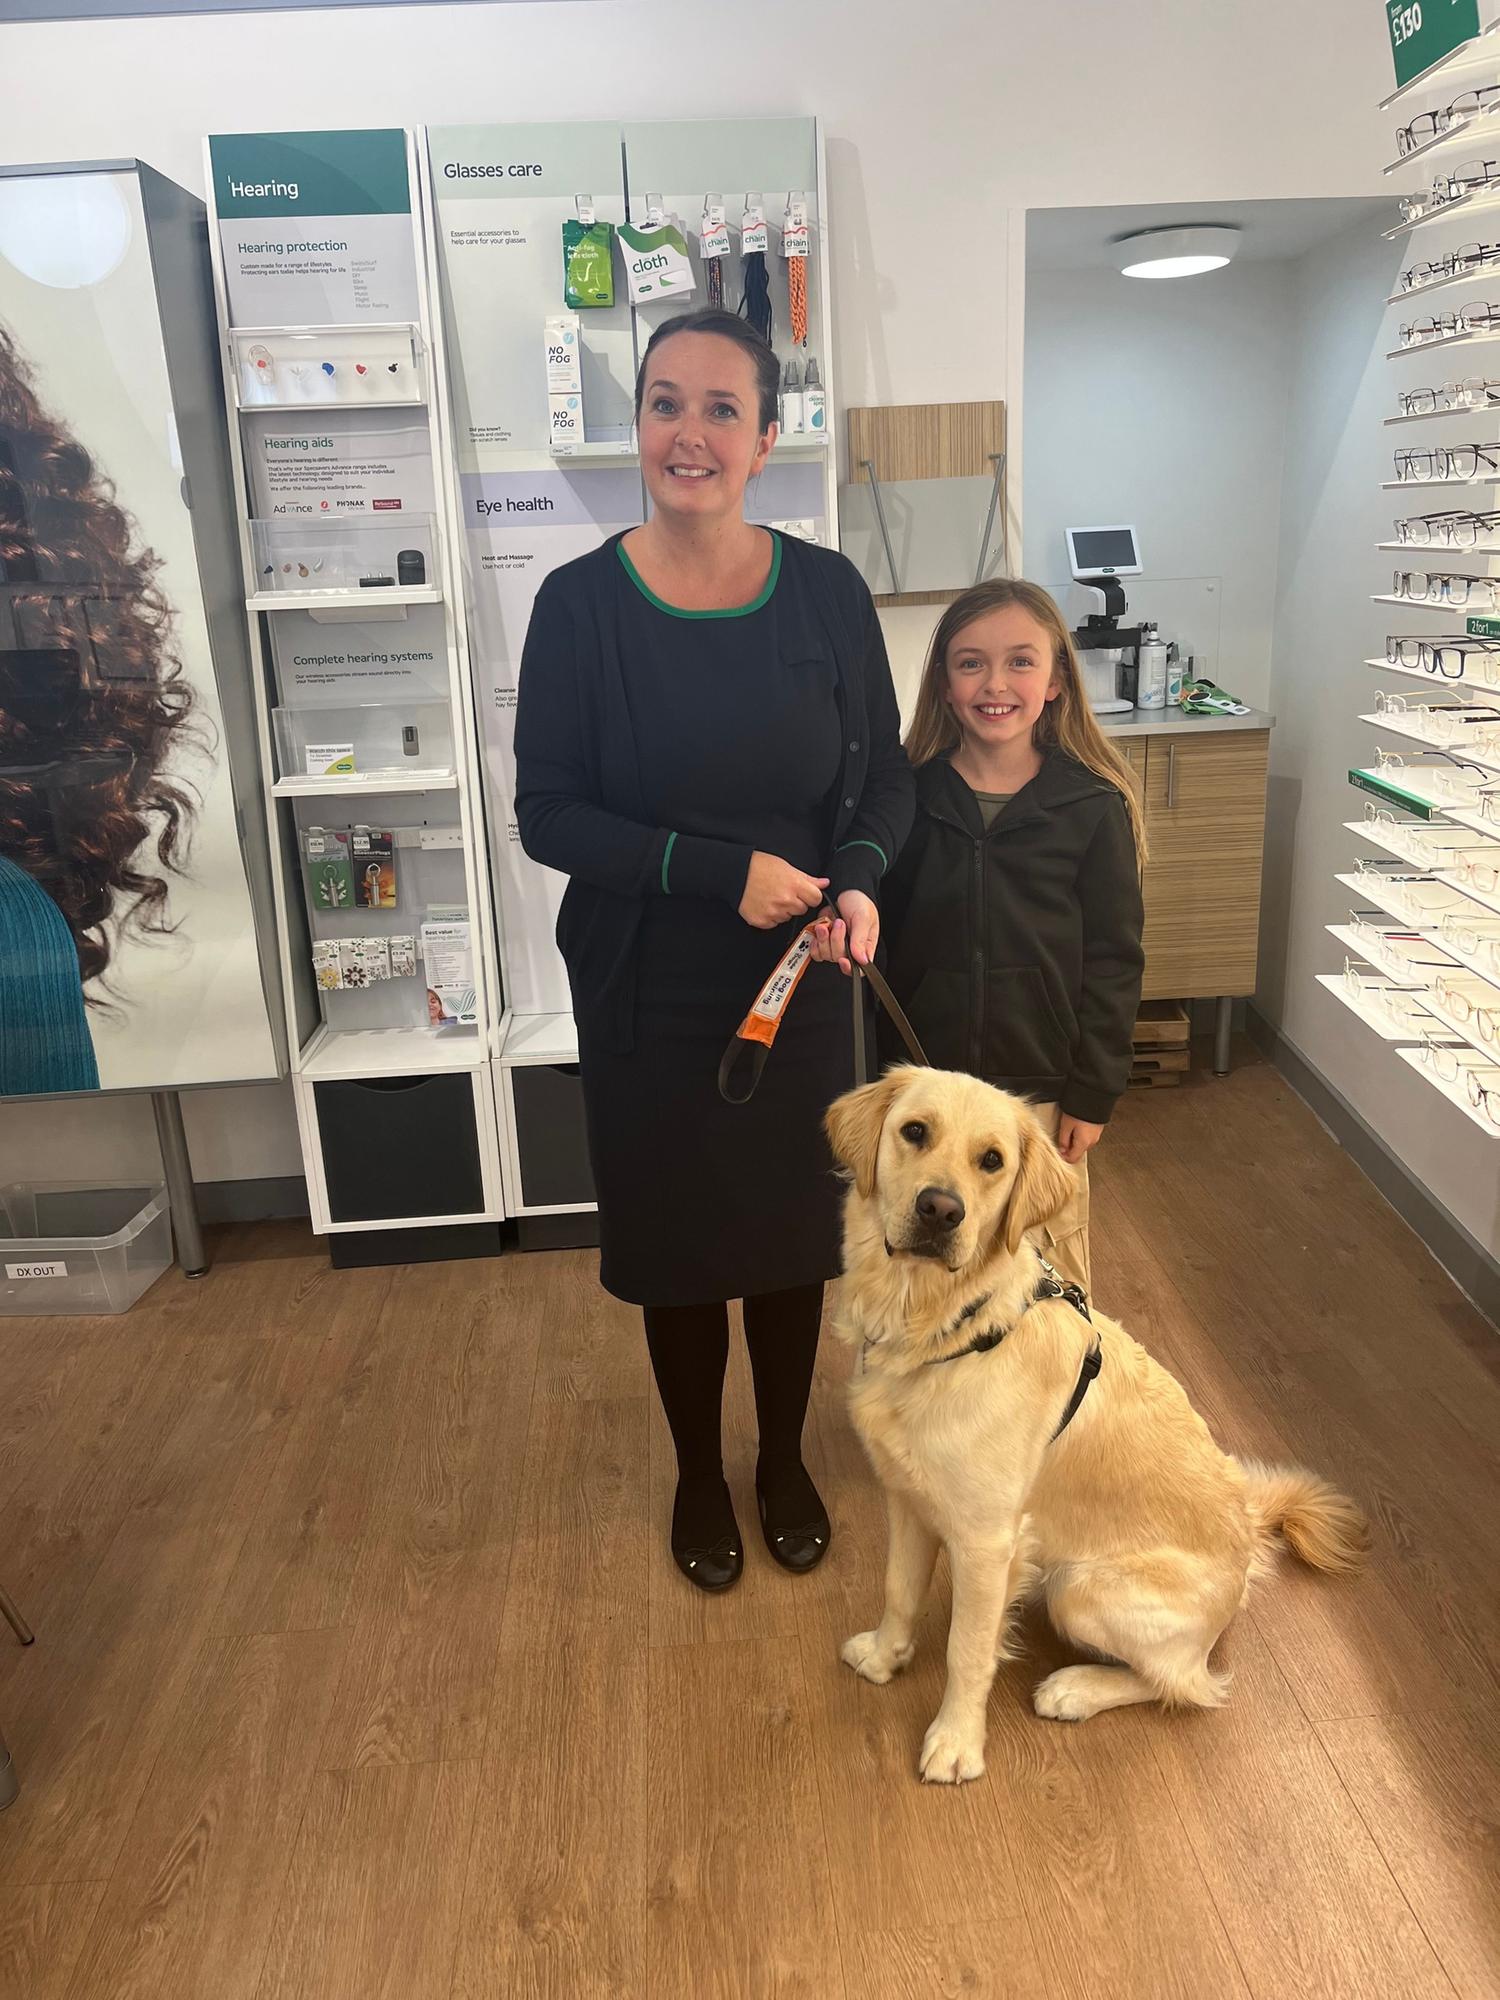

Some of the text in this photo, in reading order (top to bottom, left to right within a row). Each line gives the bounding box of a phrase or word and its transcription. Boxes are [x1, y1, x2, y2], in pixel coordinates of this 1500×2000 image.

[1393, 2, 1422, 47] £130
[444, 163, 543, 178] Glasses care
[231, 180, 299, 199] Hearing
[505, 237, 527, 245] glasses
[707, 238, 728, 248] chain
[744, 234, 766, 244] chain
[786, 239, 807, 248] chain
[238, 240, 348, 254] Hearing protection
[632, 254, 669, 273] cloth
[548, 346, 564, 355] NO
[549, 355, 571, 363] FOG
[553, 411, 568, 419] NO
[553, 420, 575, 428] FOG
[264, 437, 334, 450] Hearing aids
[476, 497, 554, 515] Eye health
[293, 651, 434, 666] Complete hearing systems
[763, 975, 785, 1005] training
[775, 977, 792, 1003] Dog in
[16, 1266, 55, 1277] DX OUT
